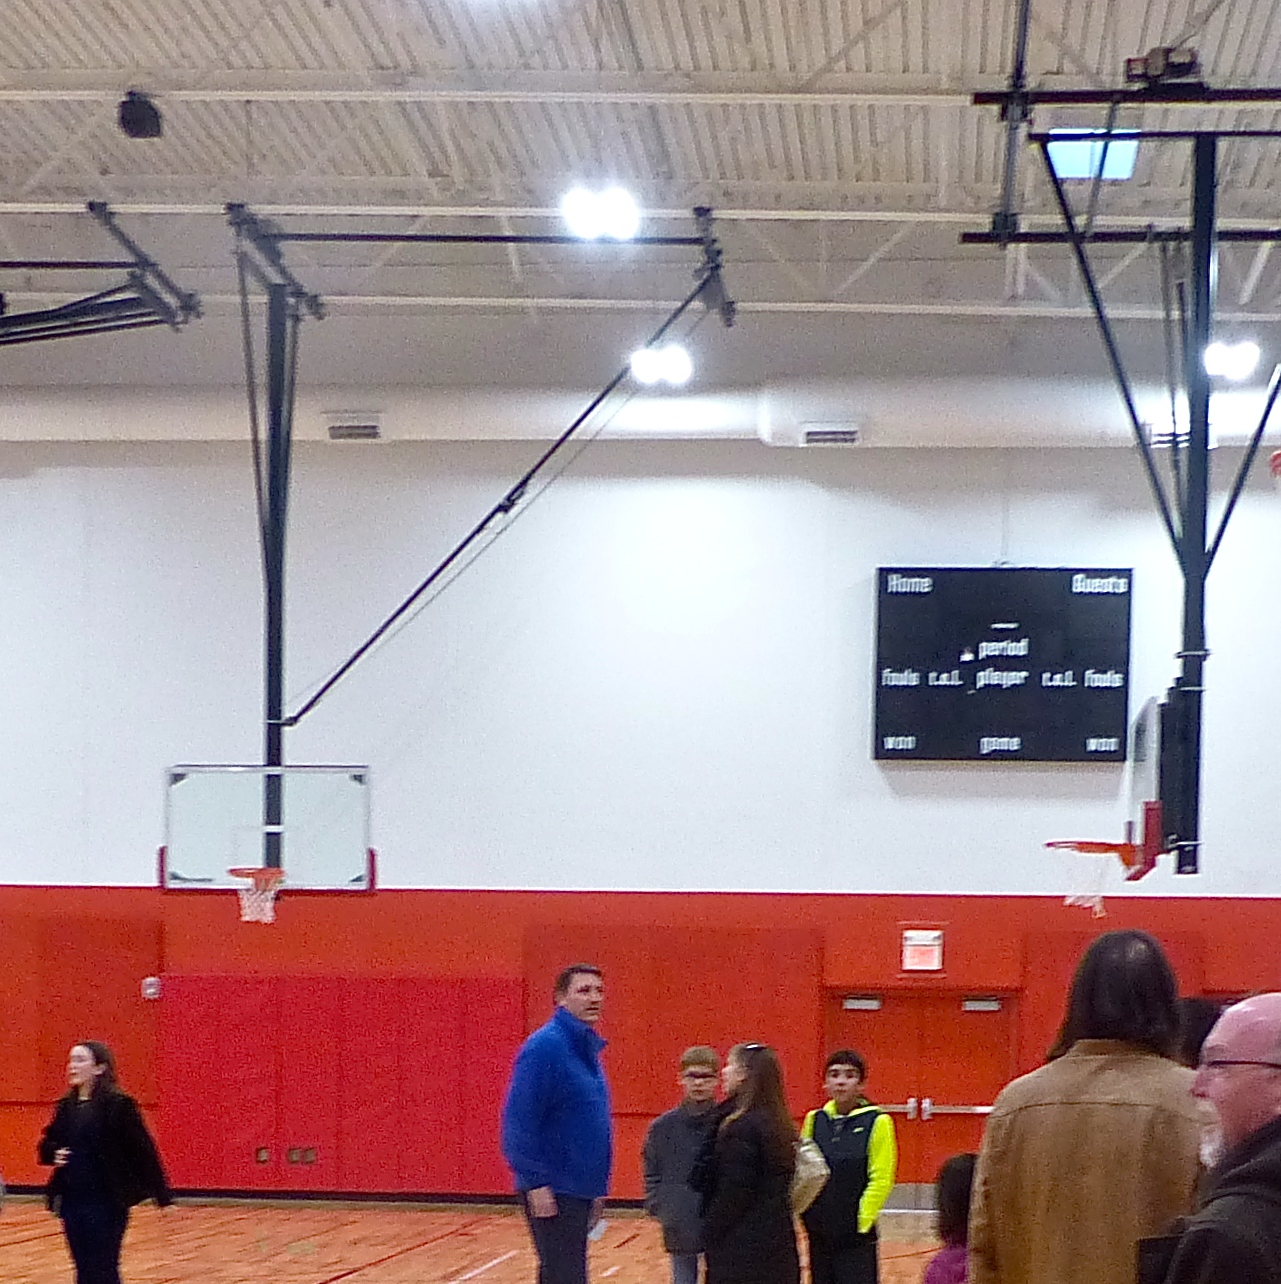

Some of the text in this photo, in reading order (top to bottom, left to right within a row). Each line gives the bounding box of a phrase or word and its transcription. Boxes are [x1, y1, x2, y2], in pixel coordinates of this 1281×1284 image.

[887, 573, 933, 593] Home
[1072, 573, 1129, 594] Guests
[978, 638, 1029, 660] period
[881, 668, 920, 686] fouls
[976, 667, 1029, 689] player
[1084, 668, 1124, 688] fouls
[883, 735, 1119, 755] won game won
